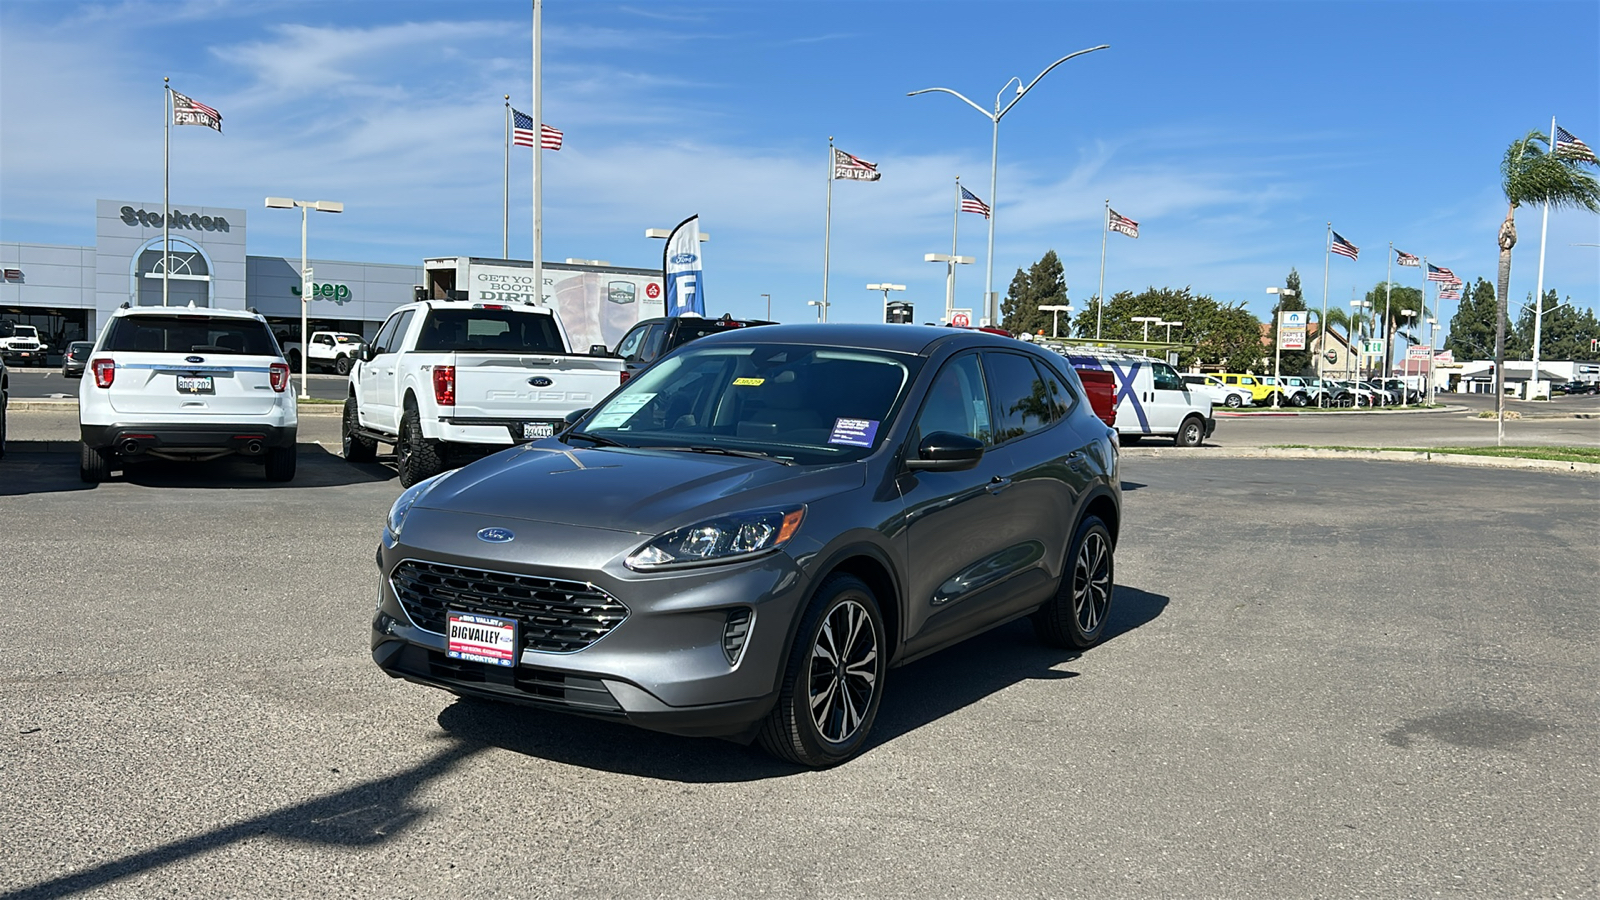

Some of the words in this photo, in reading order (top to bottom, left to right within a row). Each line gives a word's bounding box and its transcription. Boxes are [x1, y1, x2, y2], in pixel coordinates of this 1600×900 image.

[175, 112, 194, 122] 250
[836, 168, 852, 178] 250
[120, 206, 229, 232] Stockton
[477, 273, 509, 283] GET
[512, 275, 554, 286] YOR
[486, 389, 593, 402] F-150
[462, 615, 475, 623] BIG
[475, 617, 499, 626] VALLEY
[451, 625, 501, 645] BIGVALLEY
[460, 652, 499, 665] STOCKTON
